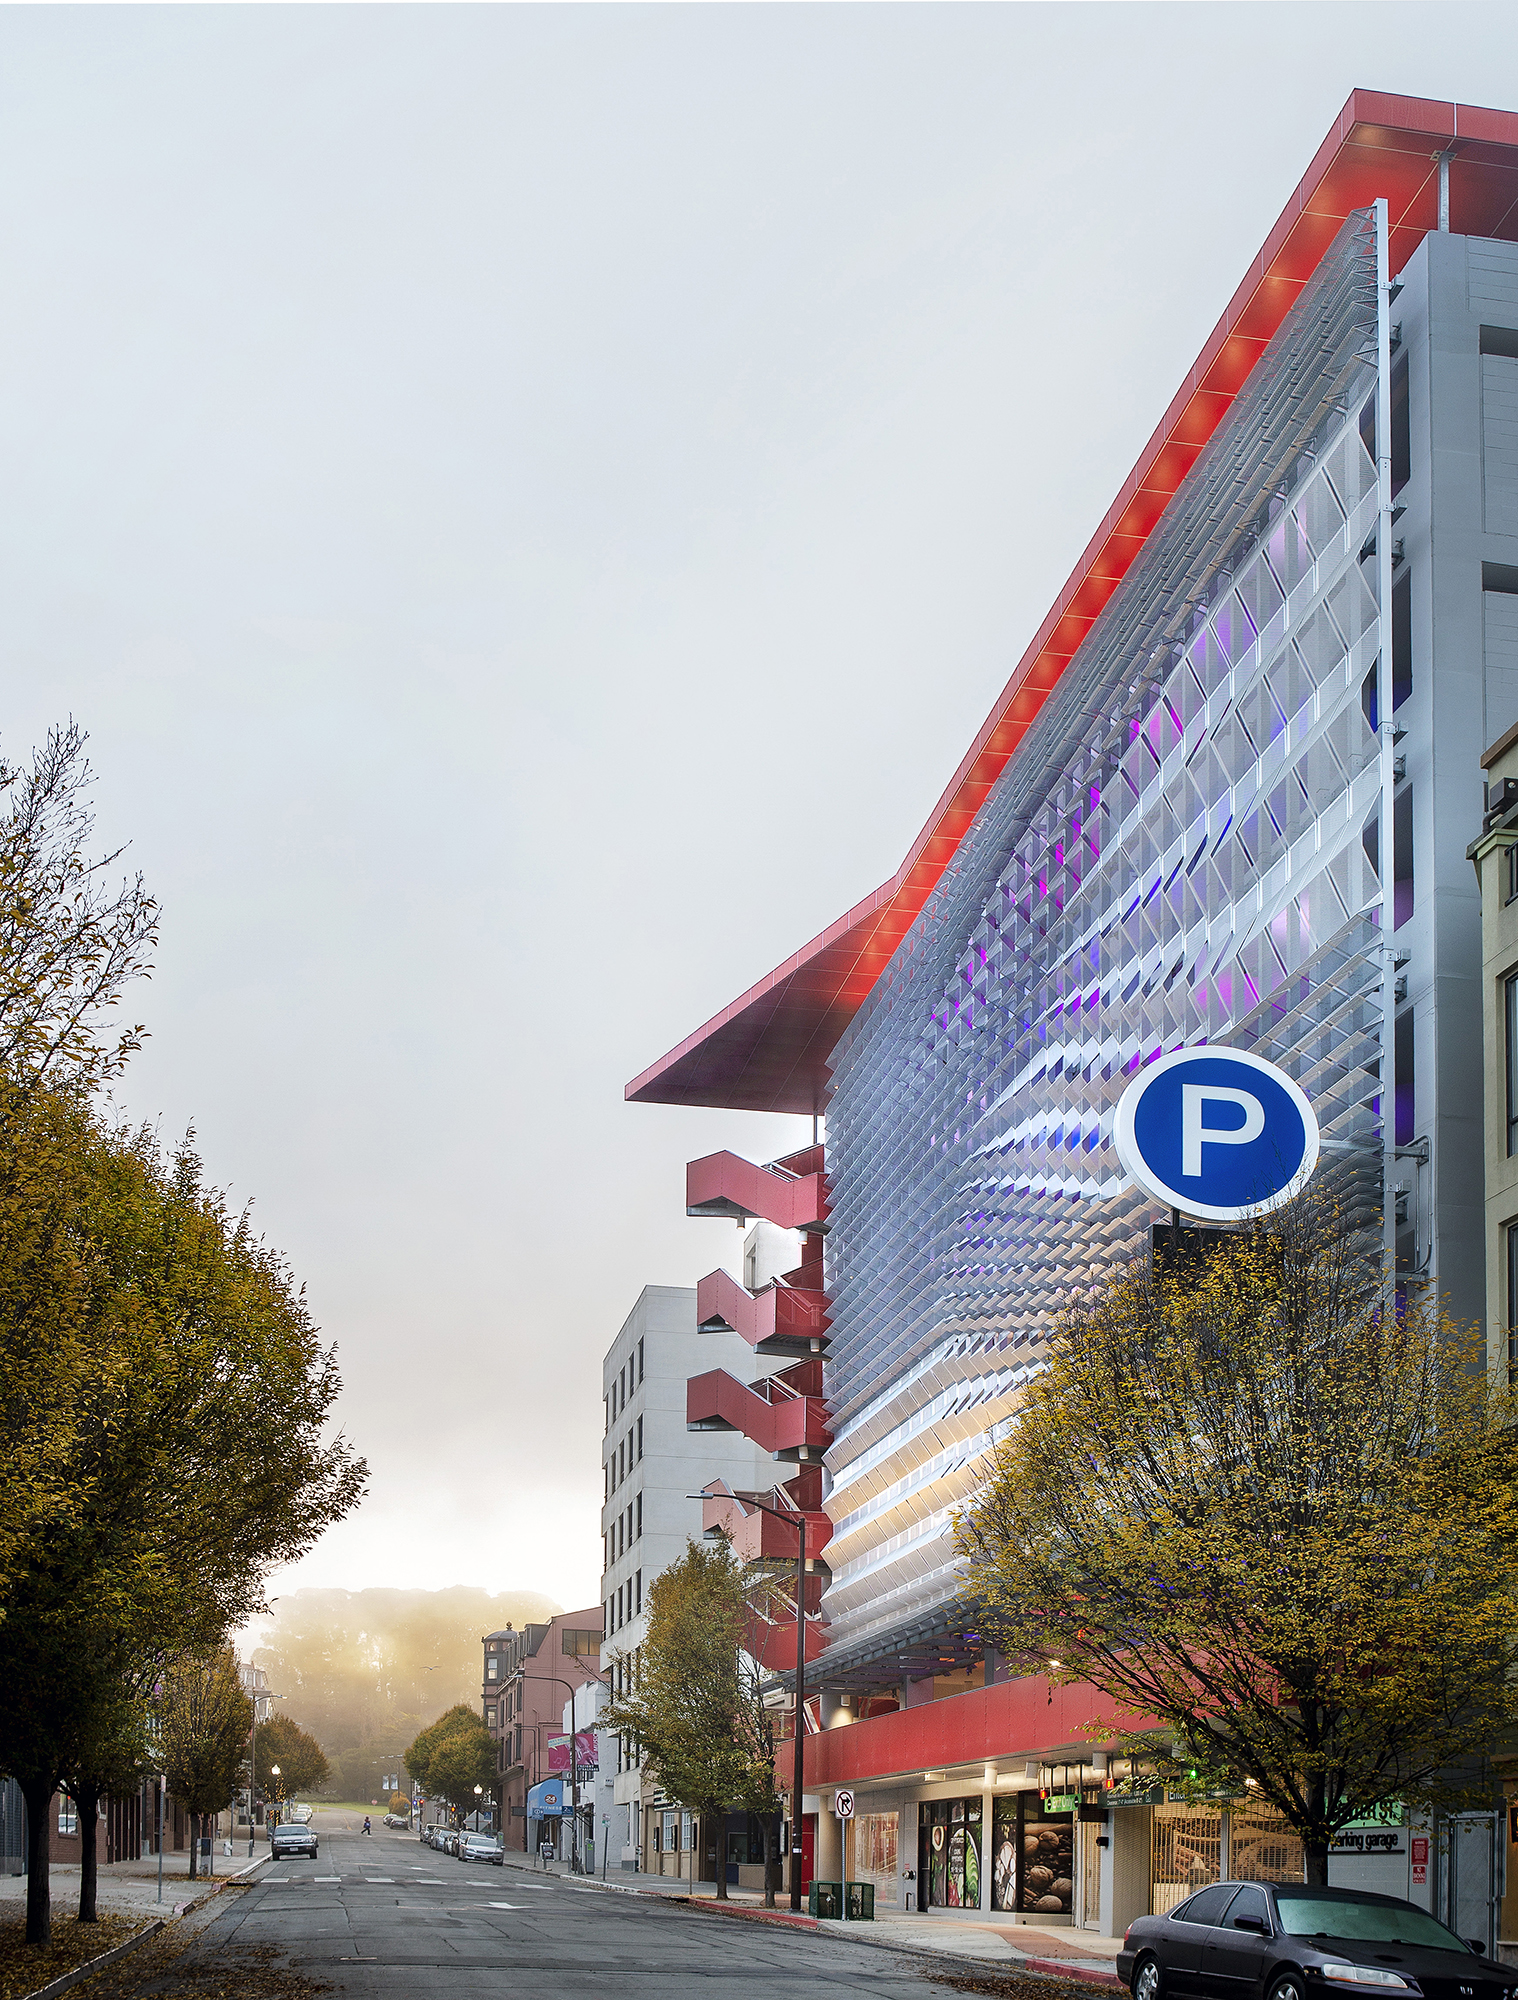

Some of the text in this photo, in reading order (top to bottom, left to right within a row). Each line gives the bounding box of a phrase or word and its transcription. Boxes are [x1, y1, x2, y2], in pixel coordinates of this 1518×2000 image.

[1182, 1083, 1266, 1177] P
[545, 1795, 556, 1803] 24
[1052, 1795, 1074, 1810] Exit Only
[1365, 1833, 1398, 1850] garage
